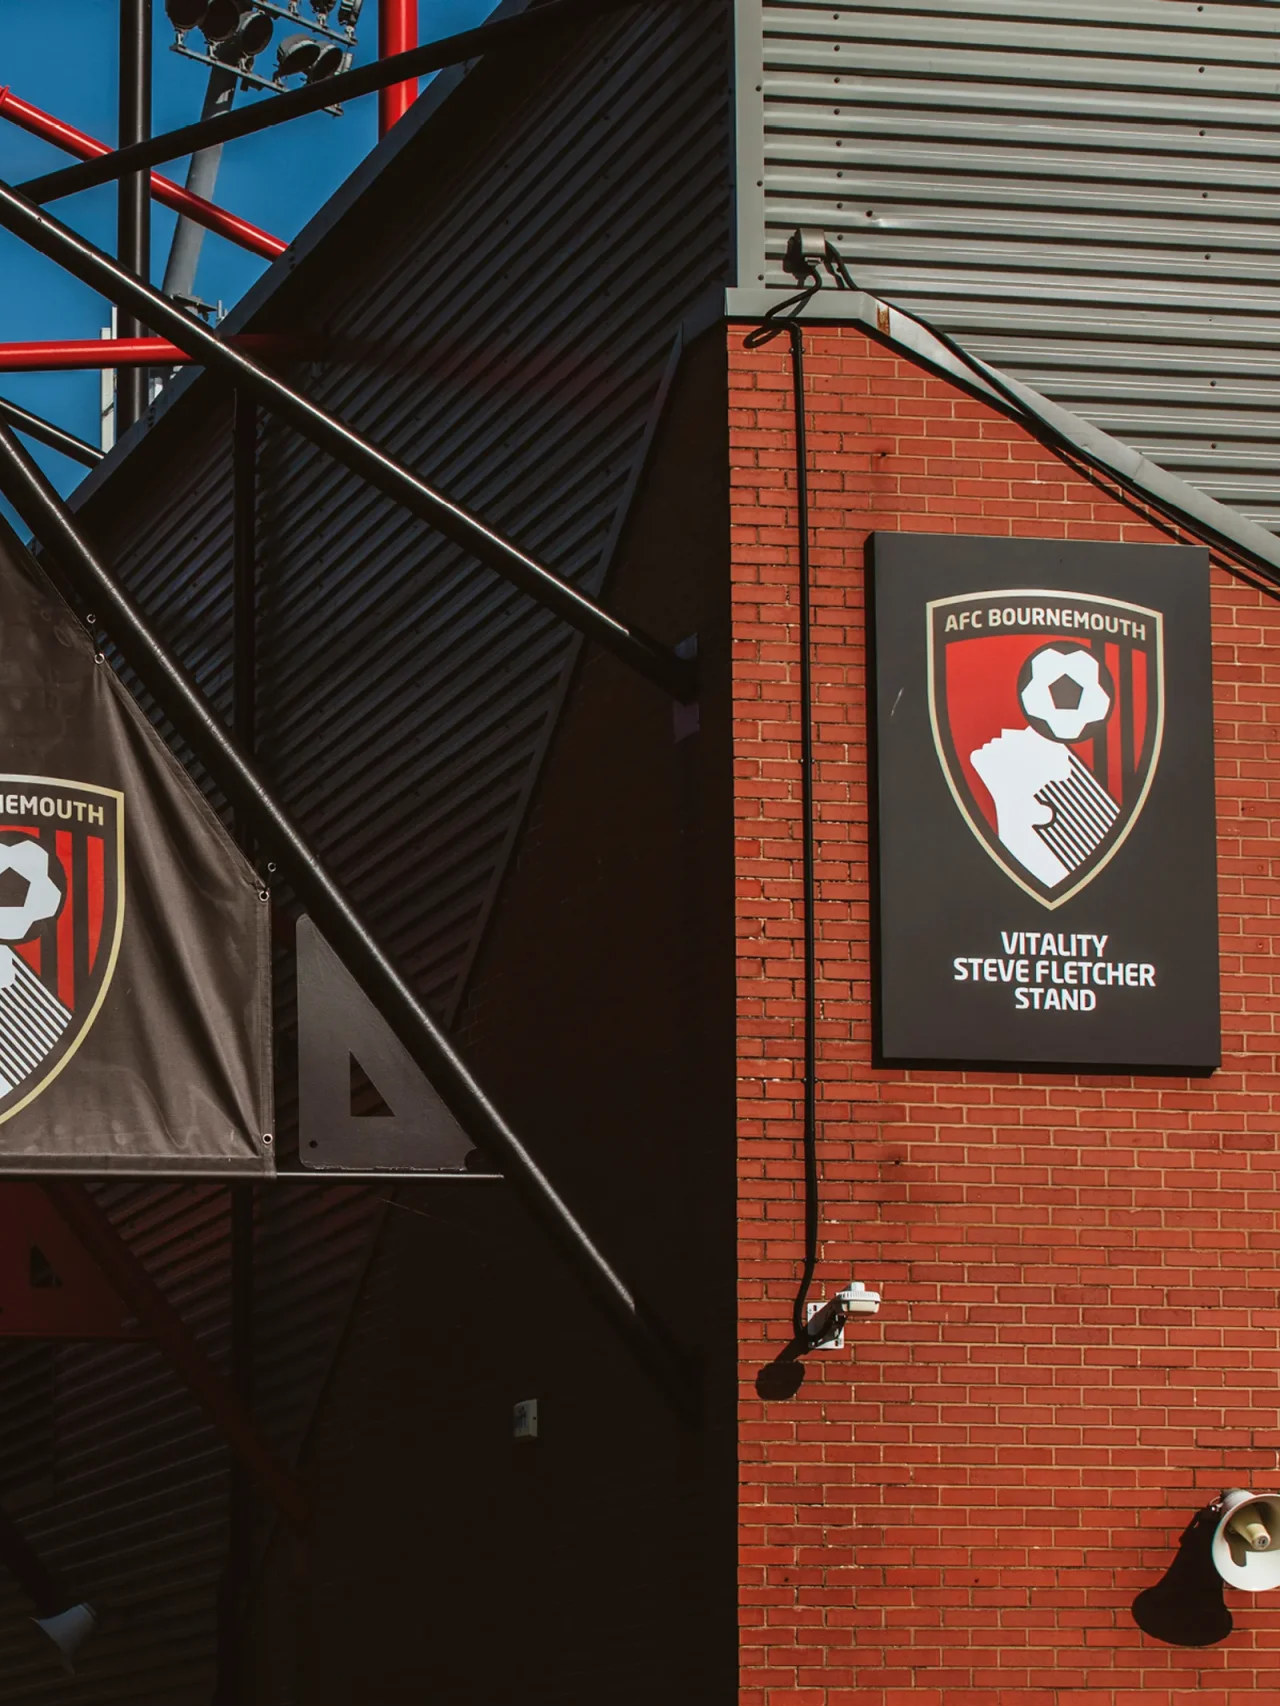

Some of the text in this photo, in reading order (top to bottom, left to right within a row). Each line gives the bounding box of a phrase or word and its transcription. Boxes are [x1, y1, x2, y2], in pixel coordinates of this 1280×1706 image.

[944, 607, 1147, 641] AFC BOURNEMOUTH
[1000, 931, 1109, 958] VITALITY
[952, 957, 1157, 987] STEVE FLETCHER
[1014, 987, 1097, 1011] STAND
